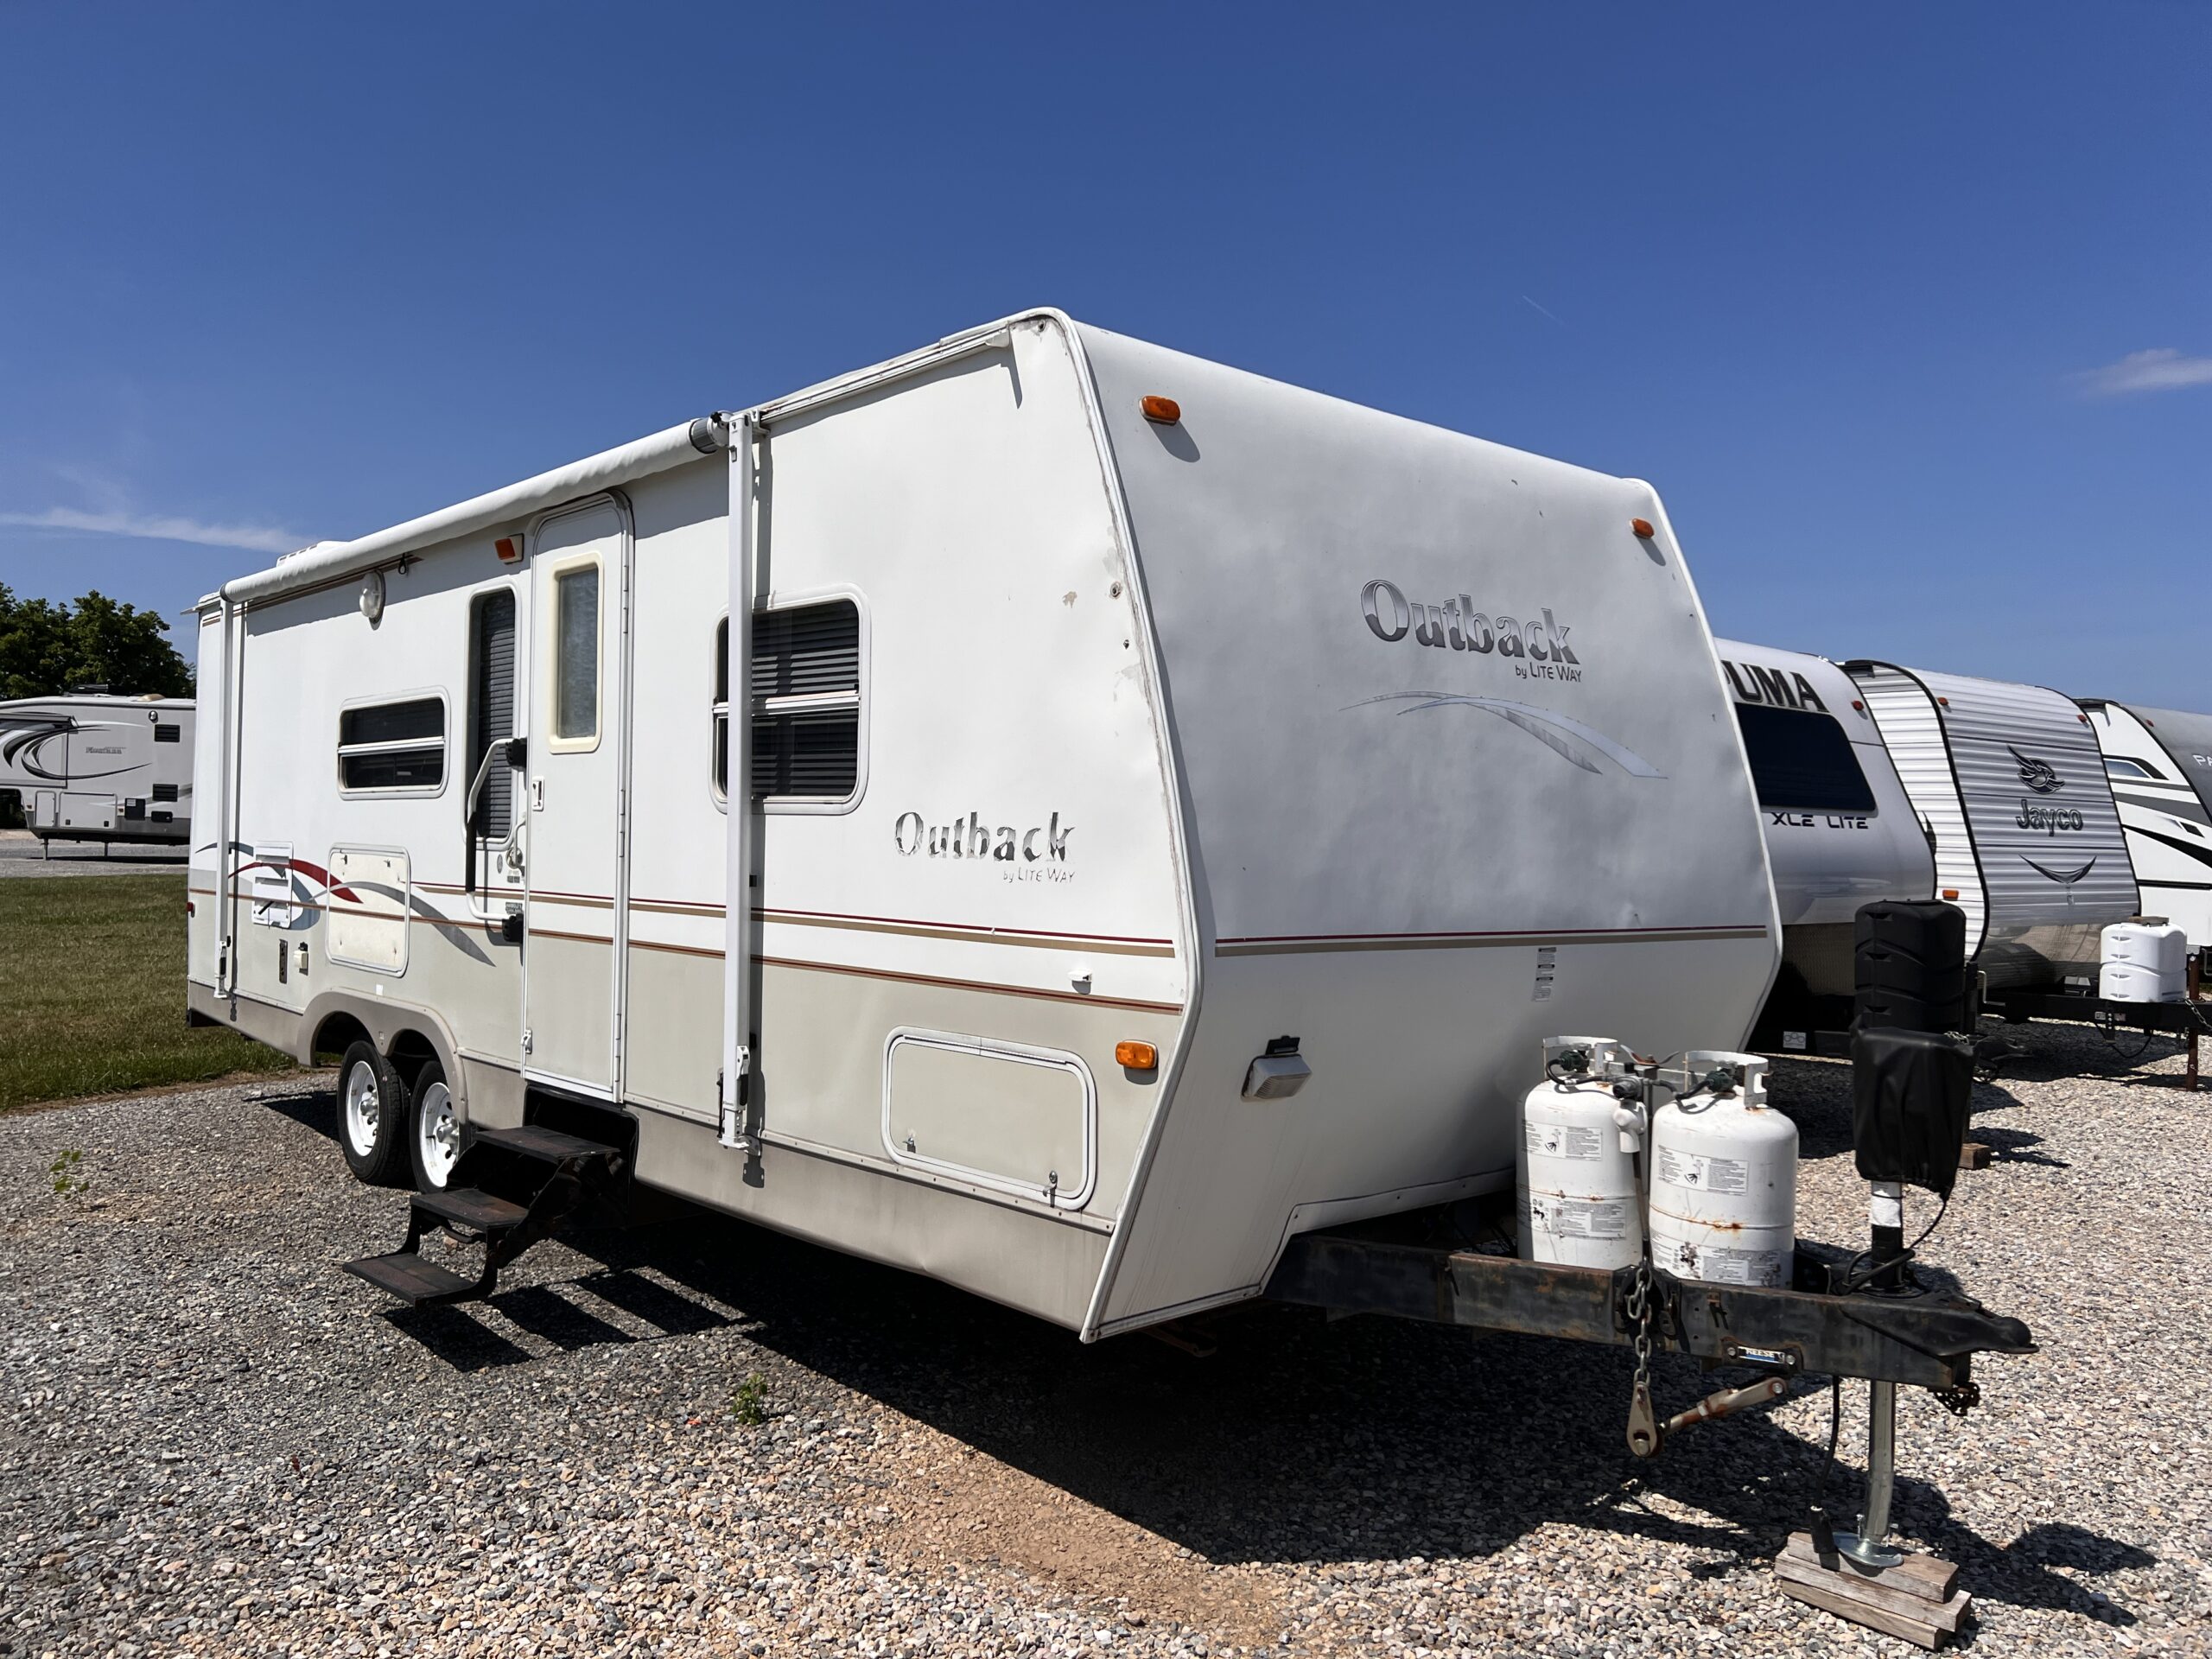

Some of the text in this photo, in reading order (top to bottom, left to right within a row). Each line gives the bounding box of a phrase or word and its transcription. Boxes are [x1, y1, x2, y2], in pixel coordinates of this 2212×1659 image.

[1360, 579, 1580, 664] Outback
[1515, 662, 1582, 683] by LITE WAY
[1720, 659, 1830, 713] UMA
[1770, 811, 1868, 830] XLE LITE
[2015, 799, 2083, 836] Jayco
[894, 811, 1076, 862] Outback
[1003, 867, 1076, 883] by LITE WAY
